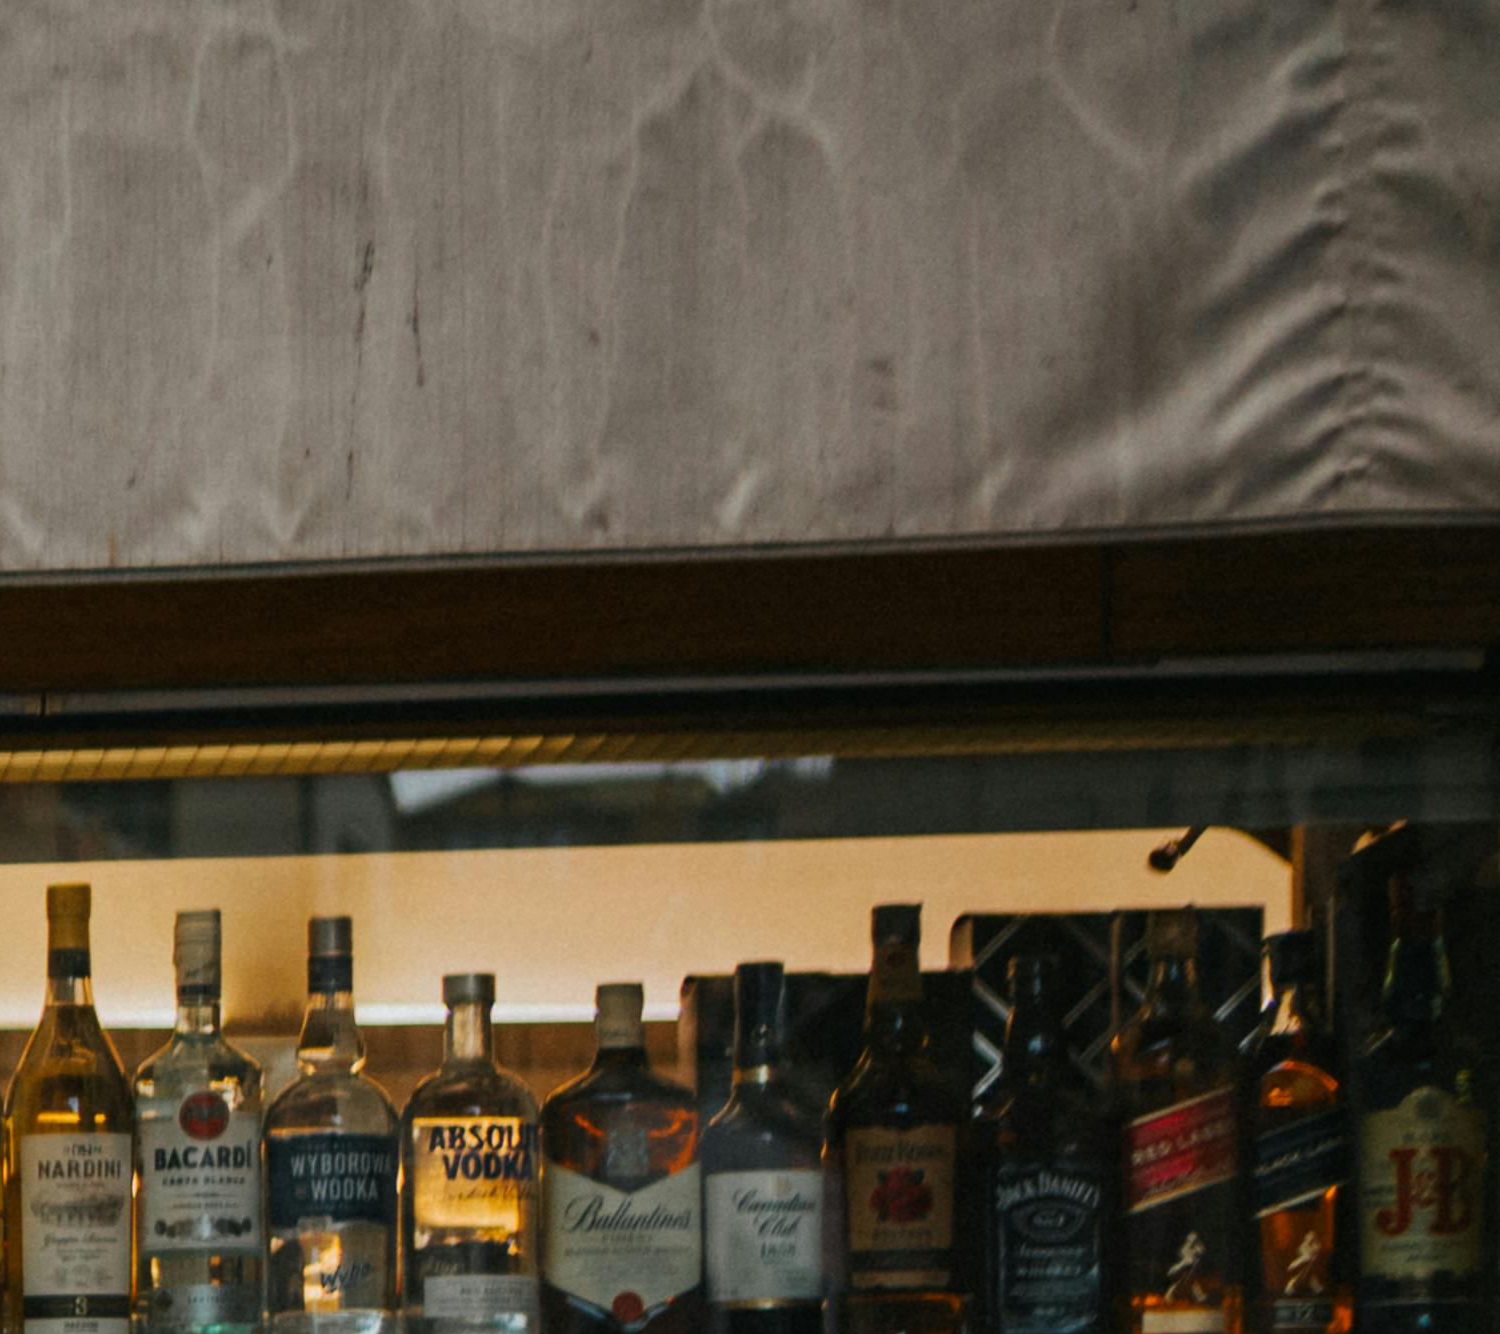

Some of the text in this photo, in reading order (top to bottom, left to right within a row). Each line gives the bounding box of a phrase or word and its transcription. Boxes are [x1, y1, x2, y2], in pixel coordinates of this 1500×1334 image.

[38, 1160, 122, 1180] NARDINI
[290, 1151, 390, 1179] WYBOROWA
[443, 1150, 534, 1181] VODKA
[310, 1178, 379, 1201] WODKA
[75, 1296, 88, 1317] 3
